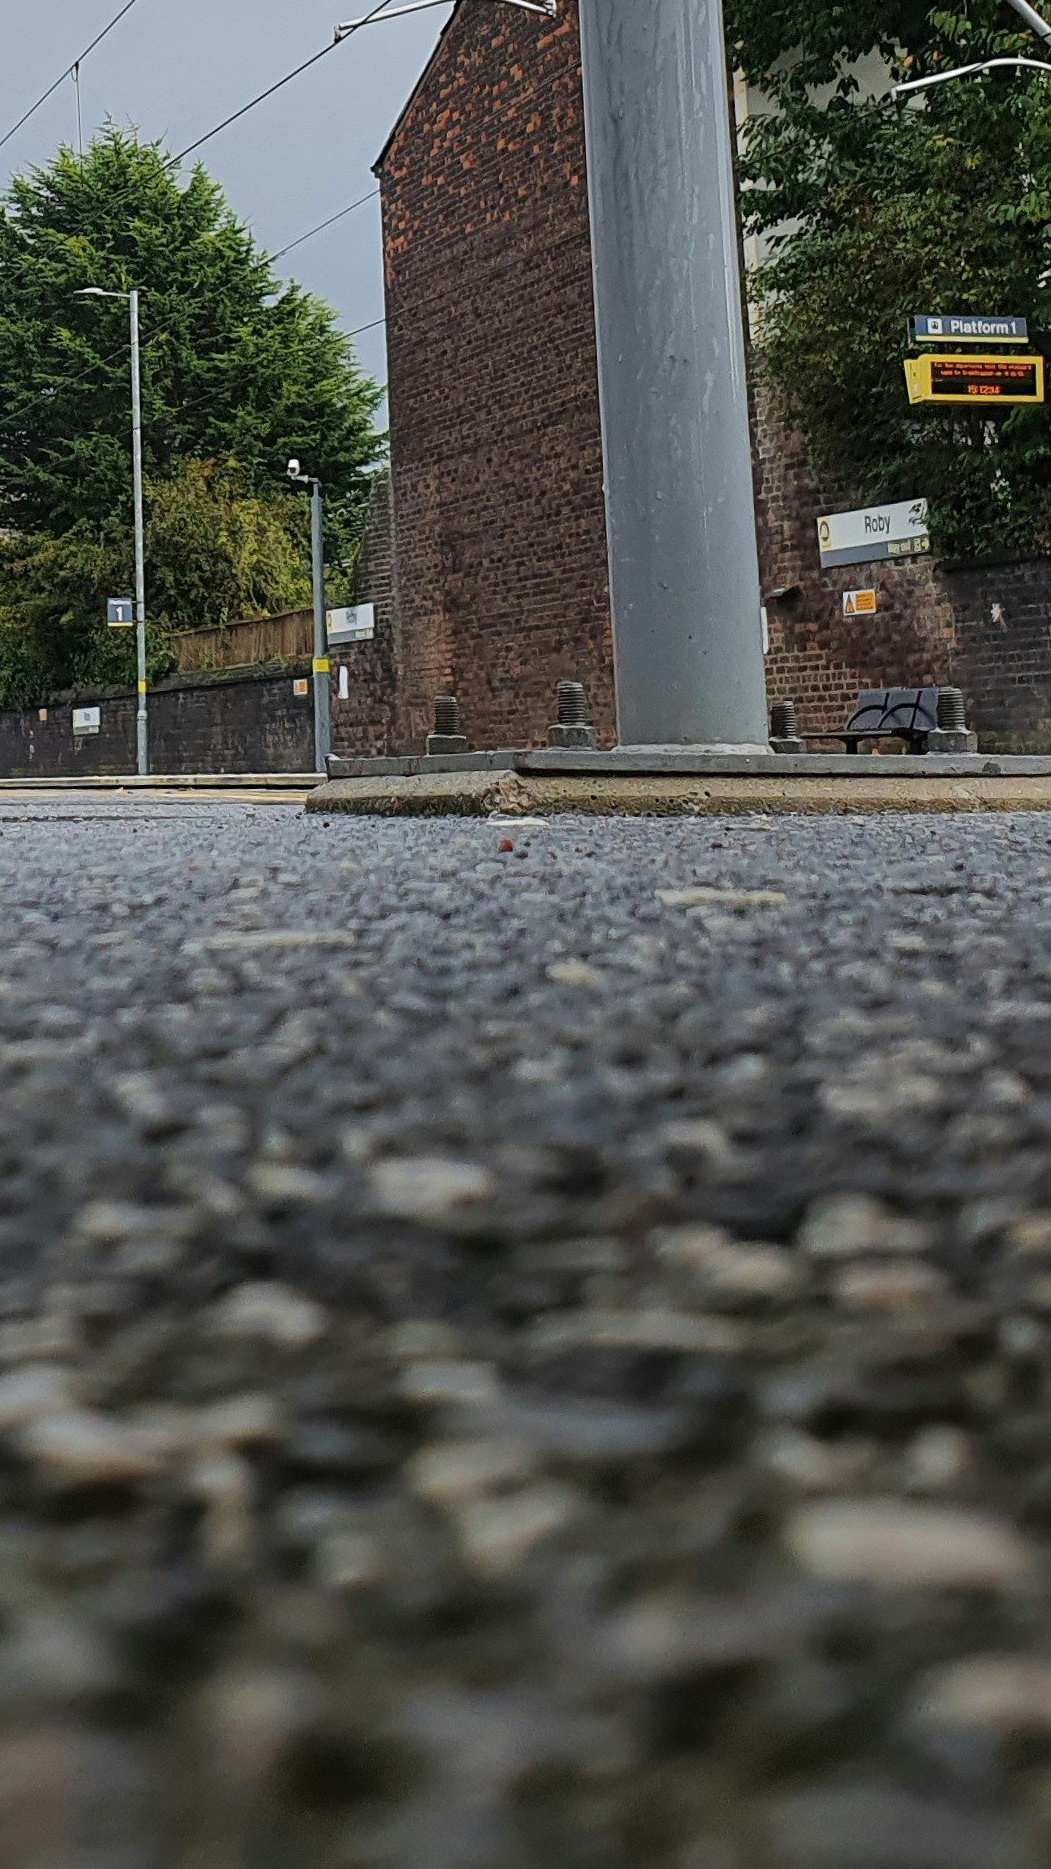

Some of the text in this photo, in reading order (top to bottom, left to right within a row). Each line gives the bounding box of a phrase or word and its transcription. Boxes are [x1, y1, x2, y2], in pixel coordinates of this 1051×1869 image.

[950, 319, 1017, 335] Platform 1
[864, 514, 891, 534] Roby
[116, 606, 123, 621] 1
